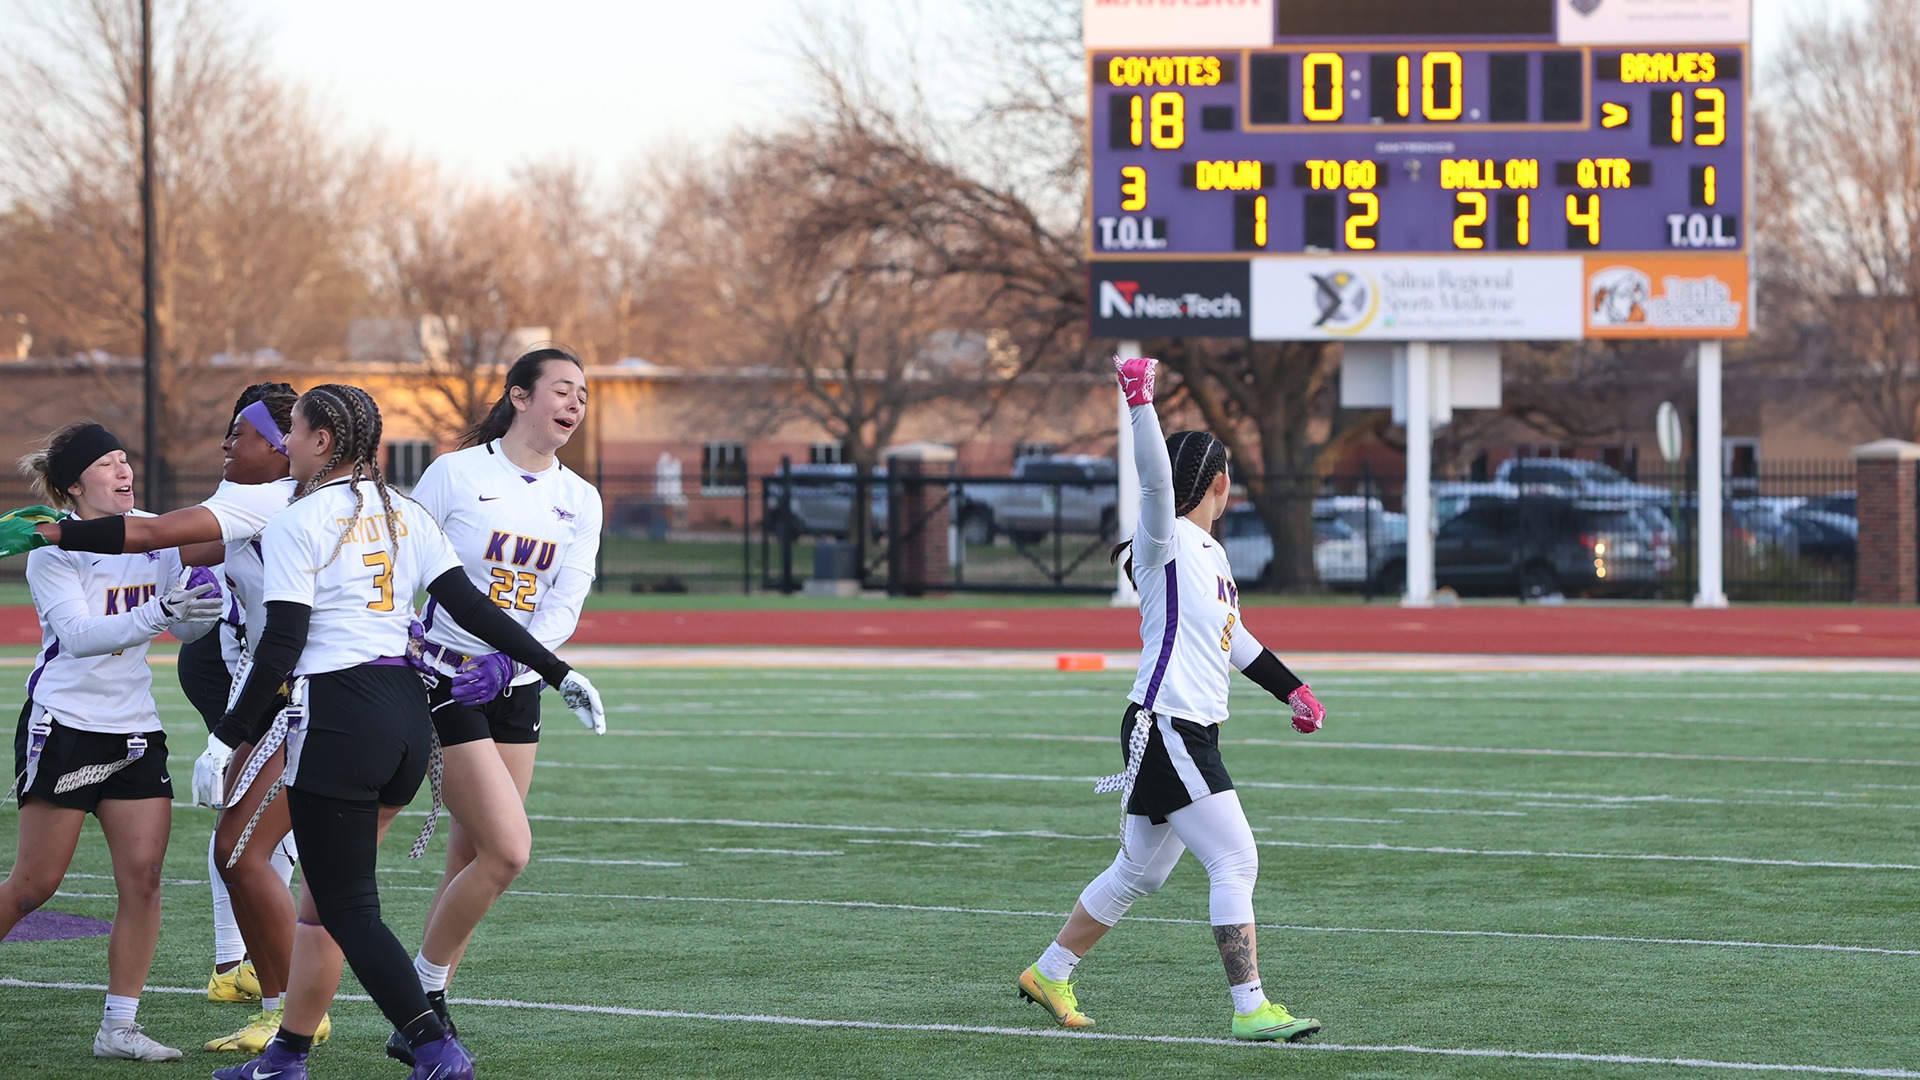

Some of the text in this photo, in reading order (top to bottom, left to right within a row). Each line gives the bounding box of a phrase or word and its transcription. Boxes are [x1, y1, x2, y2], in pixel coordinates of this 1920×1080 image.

[1109, 56, 1221, 87] COYOTES
[1620, 52, 1716, 83] BRAVES
[1130, 91, 1184, 149] 18
[1671, 88, 1725, 146] 13
[1121, 166, 1146, 211] 3
[1196, 160, 1261, 191] DOWN
[1305, 160, 1376, 190] TO GO
[1440, 159, 1538, 189] BALL ON
[1577, 158, 1631, 189] QTR
[1703, 165, 1716, 206] 1
[1098, 217, 1167, 249] T.O.L.
[1254, 195, 1268, 247] 1
[1345, 192, 1379, 250] 2
[1566, 194, 1600, 245] 4
[1666, 213, 1736, 247] T.O.L.
[336, 510, 409, 544] COYOTS
[483, 529, 558, 572] KWU
[362, 550, 395, 611] 3
[489, 567, 537, 612] 22
